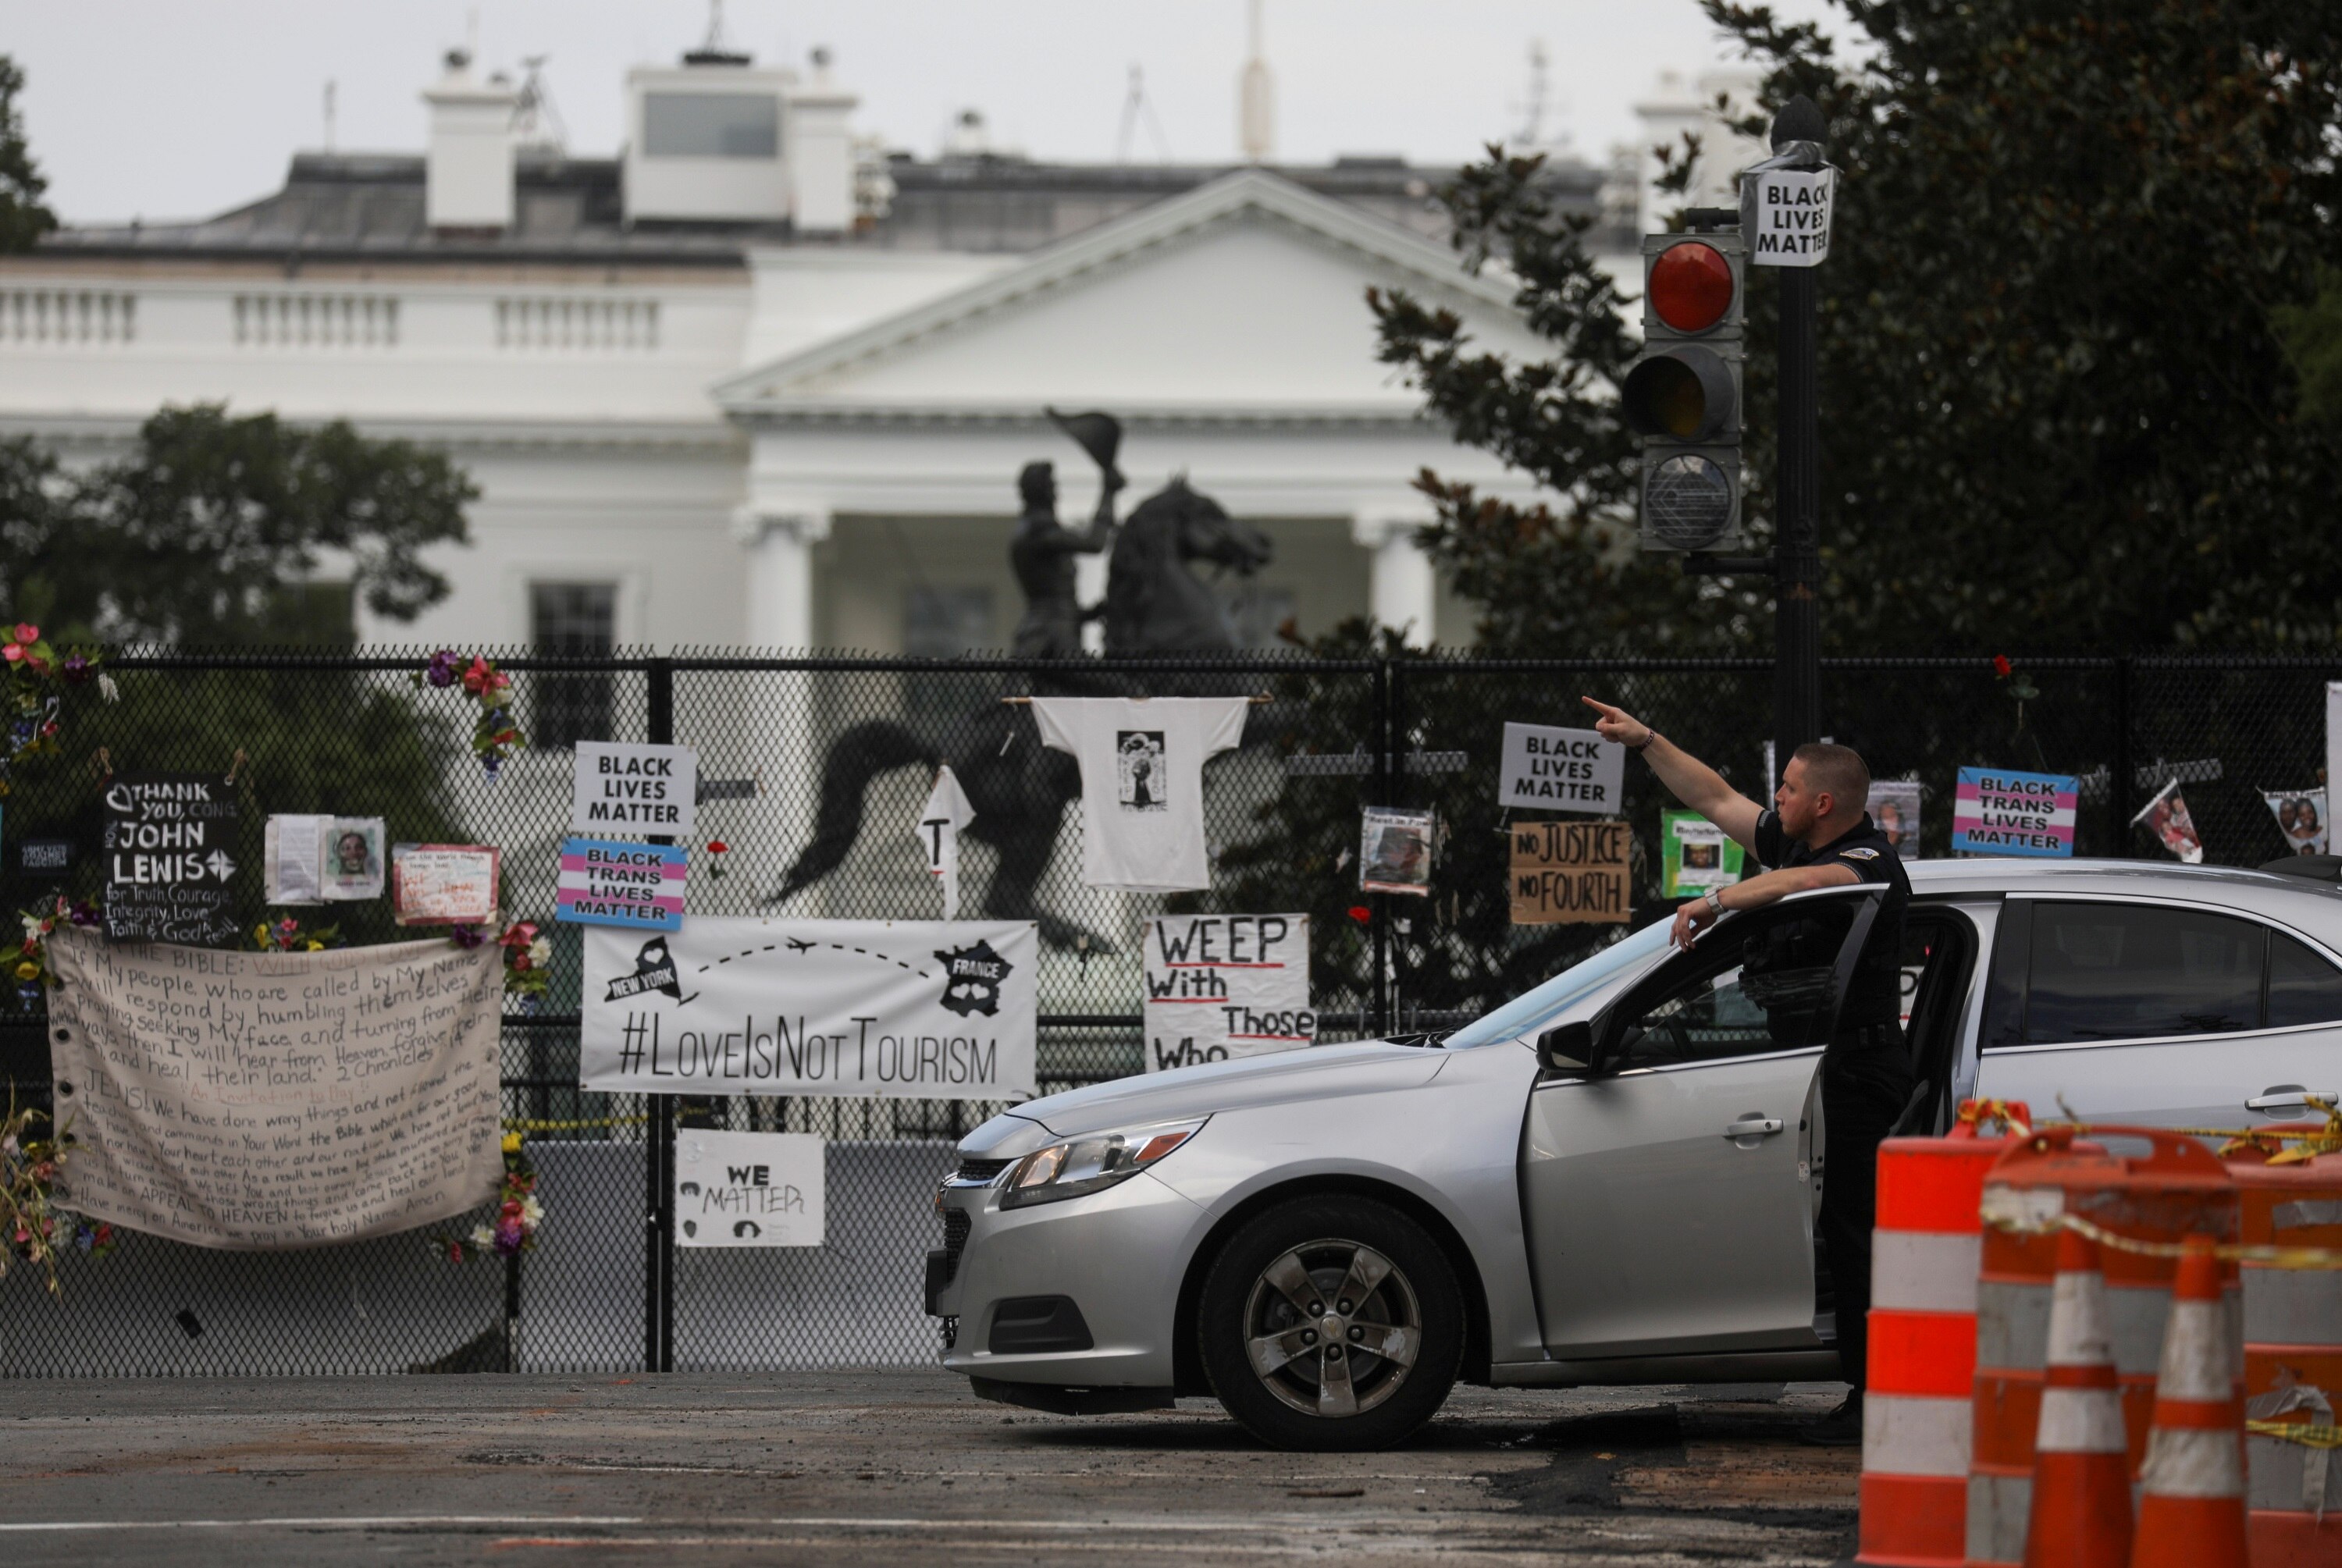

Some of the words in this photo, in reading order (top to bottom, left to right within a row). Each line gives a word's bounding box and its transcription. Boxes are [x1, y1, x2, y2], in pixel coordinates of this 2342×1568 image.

[1767, 184, 1828, 205] BLACK
[1774, 209, 1824, 229] LIVES
[1526, 737, 1600, 759] BLACK
[599, 756, 673, 777] BLACK
[1531, 758, 1593, 780] LIVES
[131, 783, 211, 802] THANK
[605, 780, 666, 799] LIVES
[1514, 778, 1606, 802] MATTER
[1980, 777, 2055, 797] BLACK
[141, 801, 185, 821] YOU,
[589, 802, 679, 823] MATTER
[1979, 795, 2055, 814] TRANS
[1982, 812, 2048, 831] LIVES
[120, 821, 204, 849] JOHN
[923, 819, 950, 866] T
[1517, 832, 1539, 854] NO
[1539, 823, 1623, 864] JUSTICE
[1967, 829, 2060, 850] MATTER
[113, 853, 205, 884] LEWIS
[587, 848, 663, 867] BLACK
[586, 866, 662, 884] TRANS
[106, 880, 126, 902] for
[589, 884, 654, 901] LIVES
[1518, 876, 1539, 898] NO
[1540, 871, 1621, 913] FOURTH
[575, 900, 667, 920] MATTER
[109, 919, 143, 937] Faith
[162, 921, 201, 941] God
[1156, 916, 1288, 963] WEEP
[173, 949, 244, 976] BIBLE:
[252, 955, 311, 975] WITH
[95, 951, 123, 986] My
[205, 978, 253, 1001] who
[257, 986, 288, 1001] are
[302, 969, 360, 999] called
[372, 971, 390, 997] by
[396, 965, 425, 994] My
[432, 952, 479, 977] Name
[610, 976, 641, 999] NEW
[641, 967, 676, 990] YORK
[952, 958, 1001, 979] FRANCE
[1147, 967, 1227, 998] With
[76, 976, 113, 997] will
[126, 993, 212, 1021] respond
[221, 1001, 245, 1032] by
[258, 1001, 346, 1027] humbling
[354, 973, 468, 1017] themselves
[77, 993, 133, 1031] praying
[137, 1015, 201, 1047] seeking
[208, 1021, 240, 1057] My
[300, 1019, 345, 1046] and
[349, 1016, 416, 1041] turning
[422, 1004, 457, 1027] from
[1221, 1006, 1315, 1037] Those
[165, 1036, 183, 1058] I
[190, 1044, 226, 1064] will
[237, 1046, 277, 1069] hear
[282, 1047, 328, 1070] from
[390, 1029, 448, 1067] forgive
[1154, 1036, 1230, 1071] Who
[109, 1050, 141, 1070] and
[148, 1053, 190, 1083] heal
[201, 1064, 260, 1087] their
[336, 1065, 351, 1083] 2
[354, 1047, 434, 1078] Chronicles
[152, 1097, 174, 1121] We
[180, 1100, 219, 1128] have
[222, 1108, 258, 1129] done
[265, 1114, 302, 1132] wrong
[305, 1104, 349, 1125] things
[354, 1093, 380, 1115] and
[384, 1085, 405, 1108] not
[241, 1132, 268, 1151] Your
[308, 1129, 331, 1147] the
[220, 1151, 251, 1169] each
[254, 1154, 288, 1171] other
[292, 1150, 315, 1167] and
[727, 1164, 770, 1186] WE
[140, 1185, 194, 1214] APPEAL
[222, 1206, 288, 1226] HEAVEN
[703, 1184, 805, 1214] MATTER
[80, 1185, 110, 1210] Have
[297, 1222, 328, 1240] Your
[329, 1216, 358, 1236] holy
